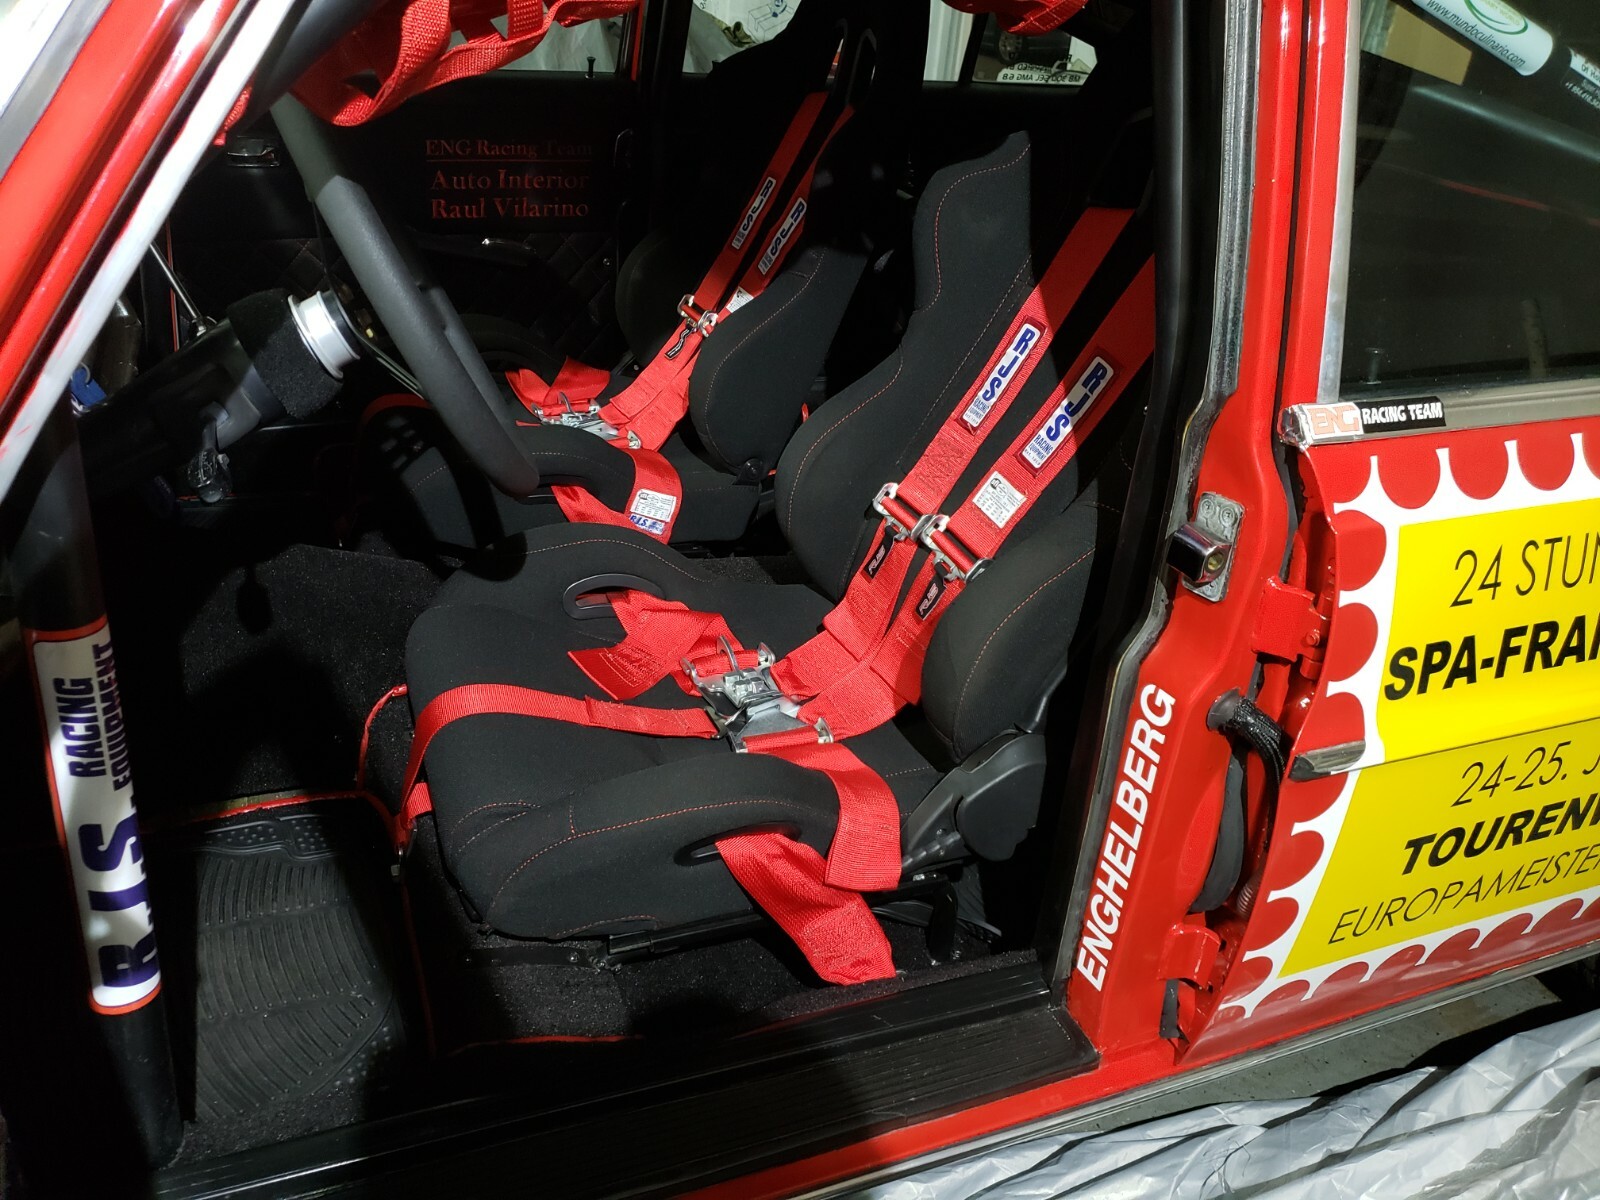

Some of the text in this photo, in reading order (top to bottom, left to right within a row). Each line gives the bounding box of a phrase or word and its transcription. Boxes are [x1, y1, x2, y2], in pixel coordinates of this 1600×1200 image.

[425, 139, 592, 159] ENG Racing Team
[430, 168, 589, 190] Auto Interior
[431, 197, 589, 219] Raul Vilarino
[743, 180, 773, 232] RJS
[770, 201, 805, 257] RJS
[982, 328, 1036, 402] RJS
[1045, 361, 1107, 442] RJS
[1307, 402, 1443, 435] ENG RACING TEAM
[1450, 544, 1503, 608] 24
[53, 678, 106, 777] RACING
[1451, 740, 1572, 807] 24-25.
[1076, 684, 1176, 992] ENGHELBERG
[1401, 792, 1600, 875] TOUREN
